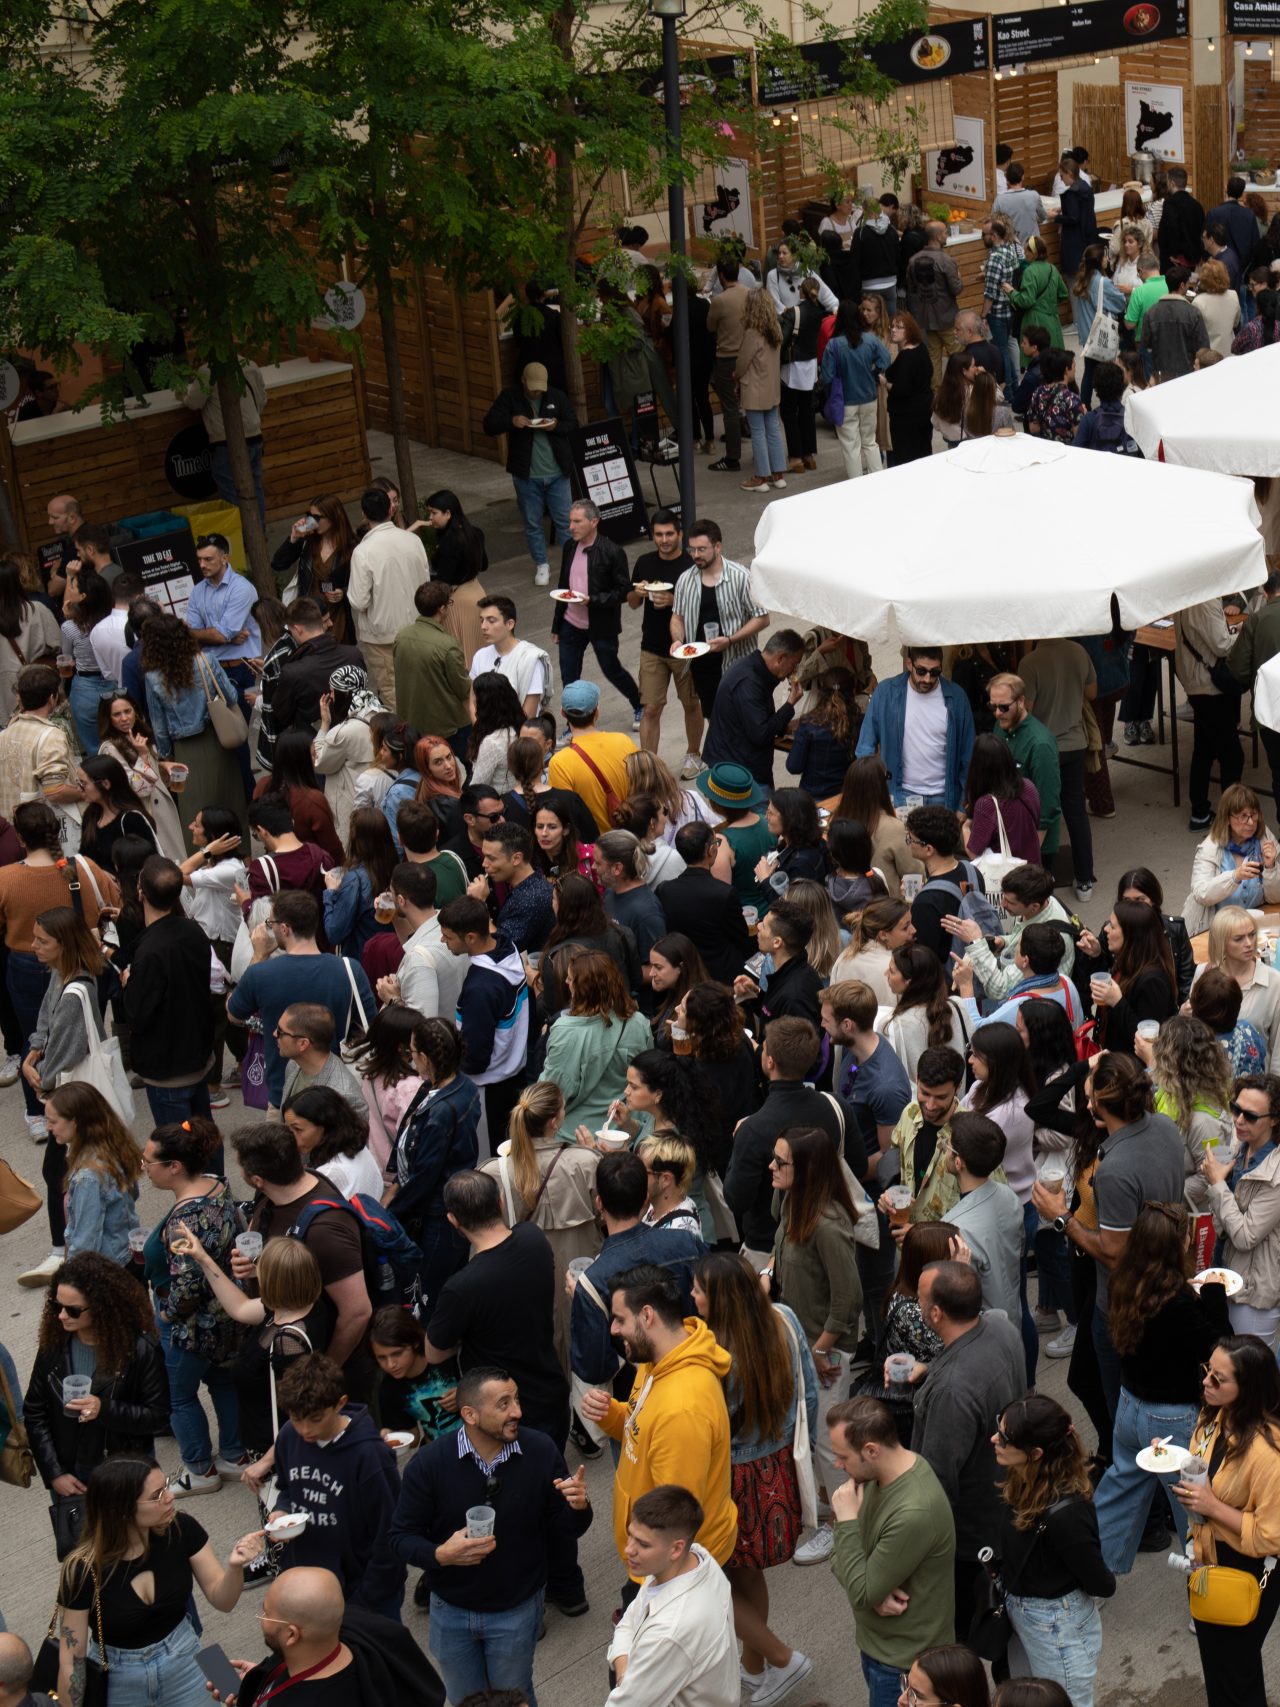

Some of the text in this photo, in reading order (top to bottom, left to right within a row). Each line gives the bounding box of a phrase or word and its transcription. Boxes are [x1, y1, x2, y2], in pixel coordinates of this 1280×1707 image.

[1234, 1, 1254, 11] Casa
[997, 30, 1010, 41] Kao
[1011, 27, 1030, 39] Street
[172, 448, 212, 479] TimeO
[289, 1465, 344, 1497] REACH
[302, 1487, 328, 1505] THE
